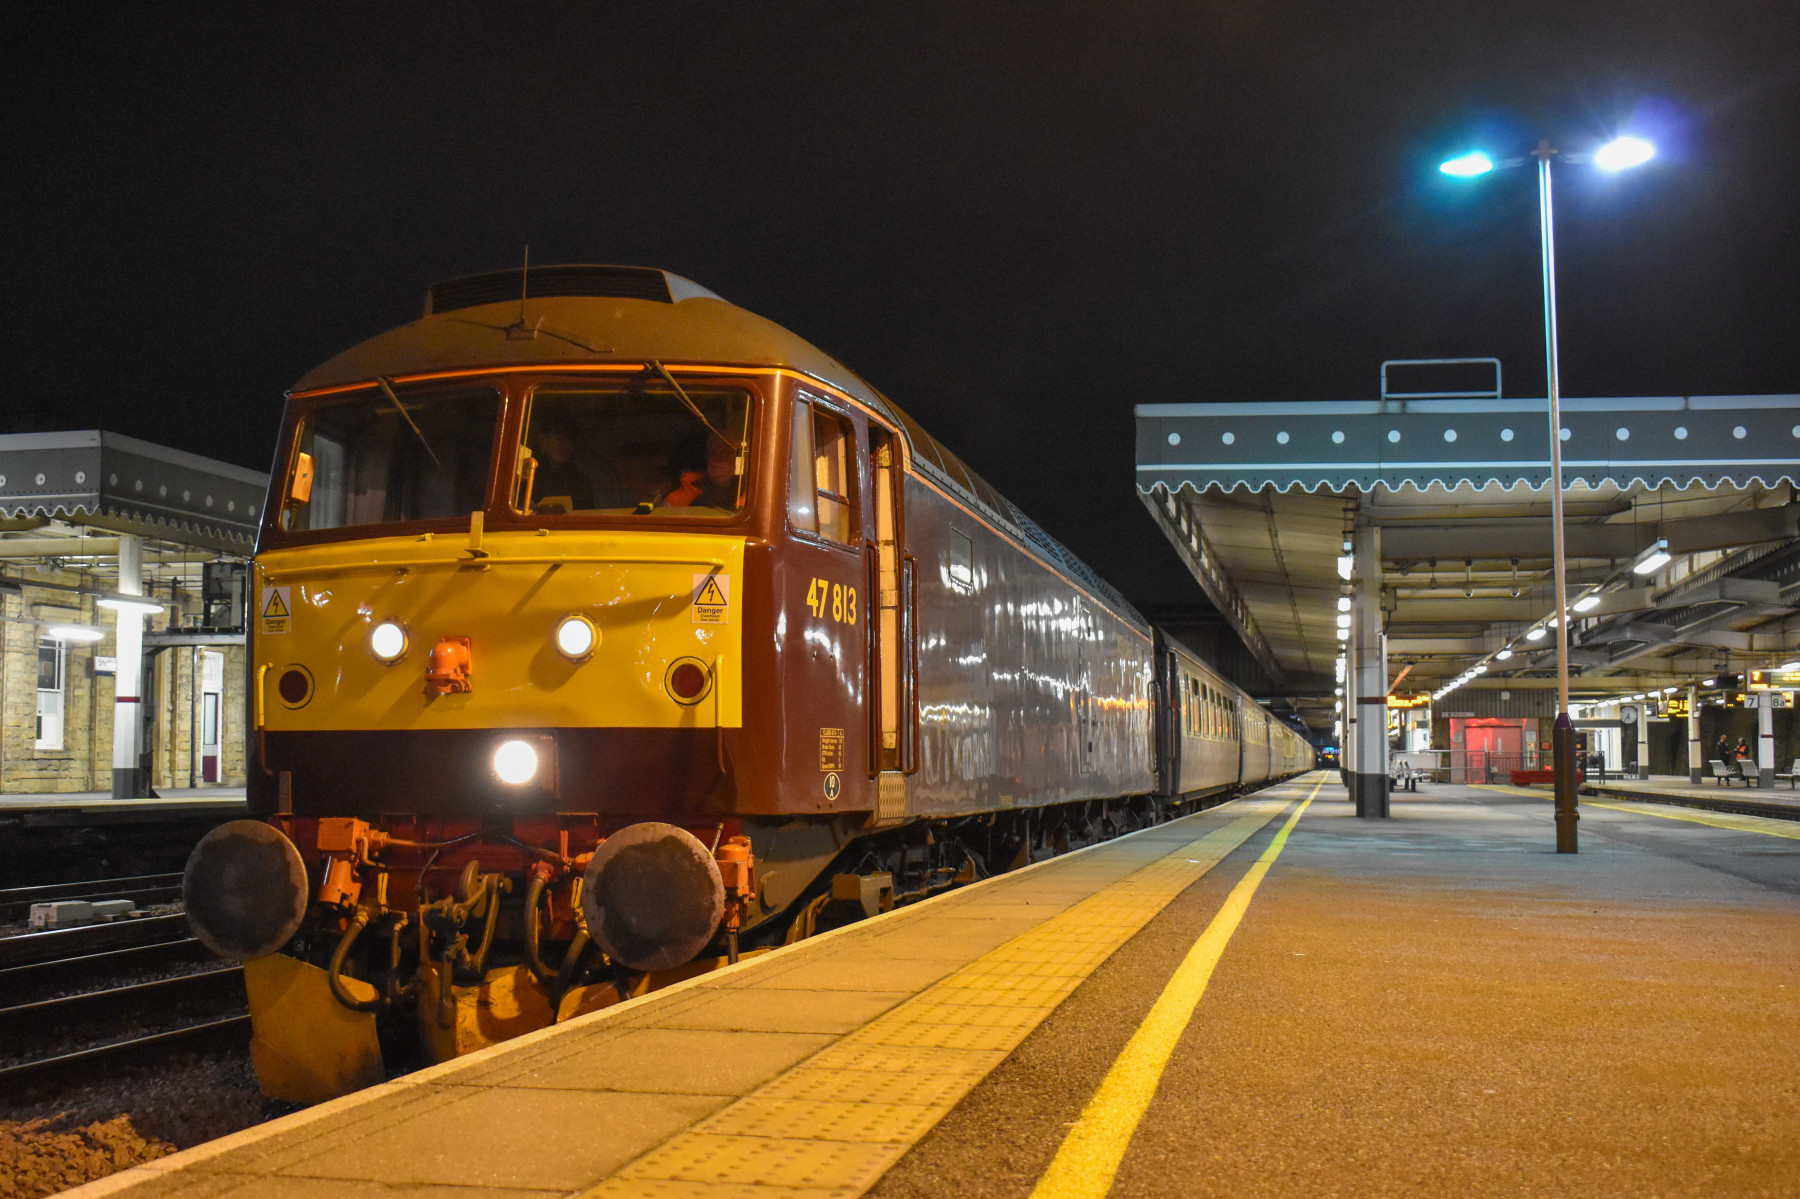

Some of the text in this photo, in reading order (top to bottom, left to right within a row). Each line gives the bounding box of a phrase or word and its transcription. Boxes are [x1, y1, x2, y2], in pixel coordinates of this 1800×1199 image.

[807, 577, 857, 625] 47 813
[697, 606, 724, 614] Danger
[1751, 671, 1761, 681] 7
[1747, 697, 1755, 708] 7
[1772, 698, 1785, 707] 8a
